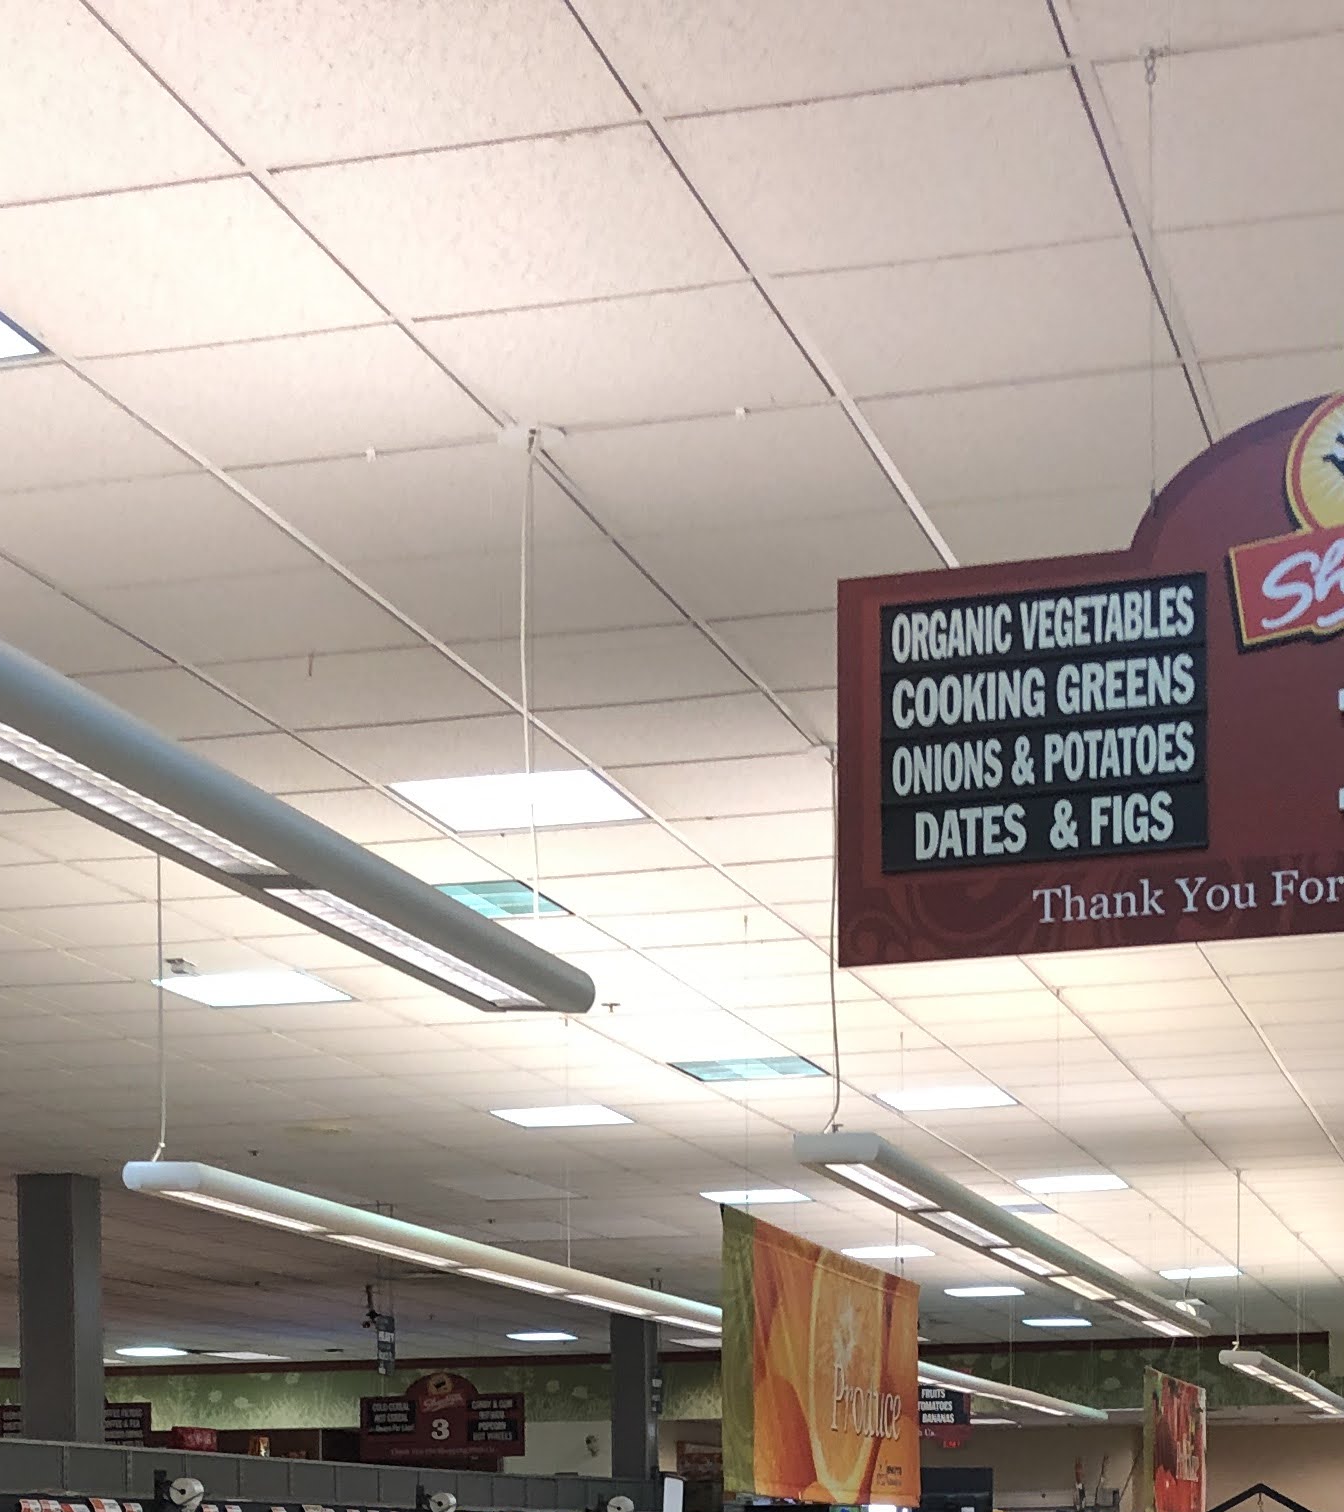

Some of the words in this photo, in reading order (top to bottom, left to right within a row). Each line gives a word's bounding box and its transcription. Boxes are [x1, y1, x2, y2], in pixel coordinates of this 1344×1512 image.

[892, 603, 1012, 663] ORGANIC
[1020, 585, 1194, 650] VEGETABLES
[892, 668, 1045, 729] COOKING
[1056, 653, 1195, 714] GREENS
[892, 738, 1002, 797] ONIONS
[1011, 736, 1034, 786] &
[1045, 721, 1195, 783] POTATOES
[915, 803, 1026, 861] DATES
[1050, 799, 1078, 850] &
[1091, 791, 1174, 847] FIGS
[1033, 882, 1165, 926] Thank
[1175, 874, 1257, 914] You
[1272, 871, 1344, 908] For
[831, 1364, 902, 1440] Produce
[921, 1389, 945, 1398] FRUITS
[922, 1413, 955, 1423] BANANAS
[431, 1418, 449, 1440] 3
